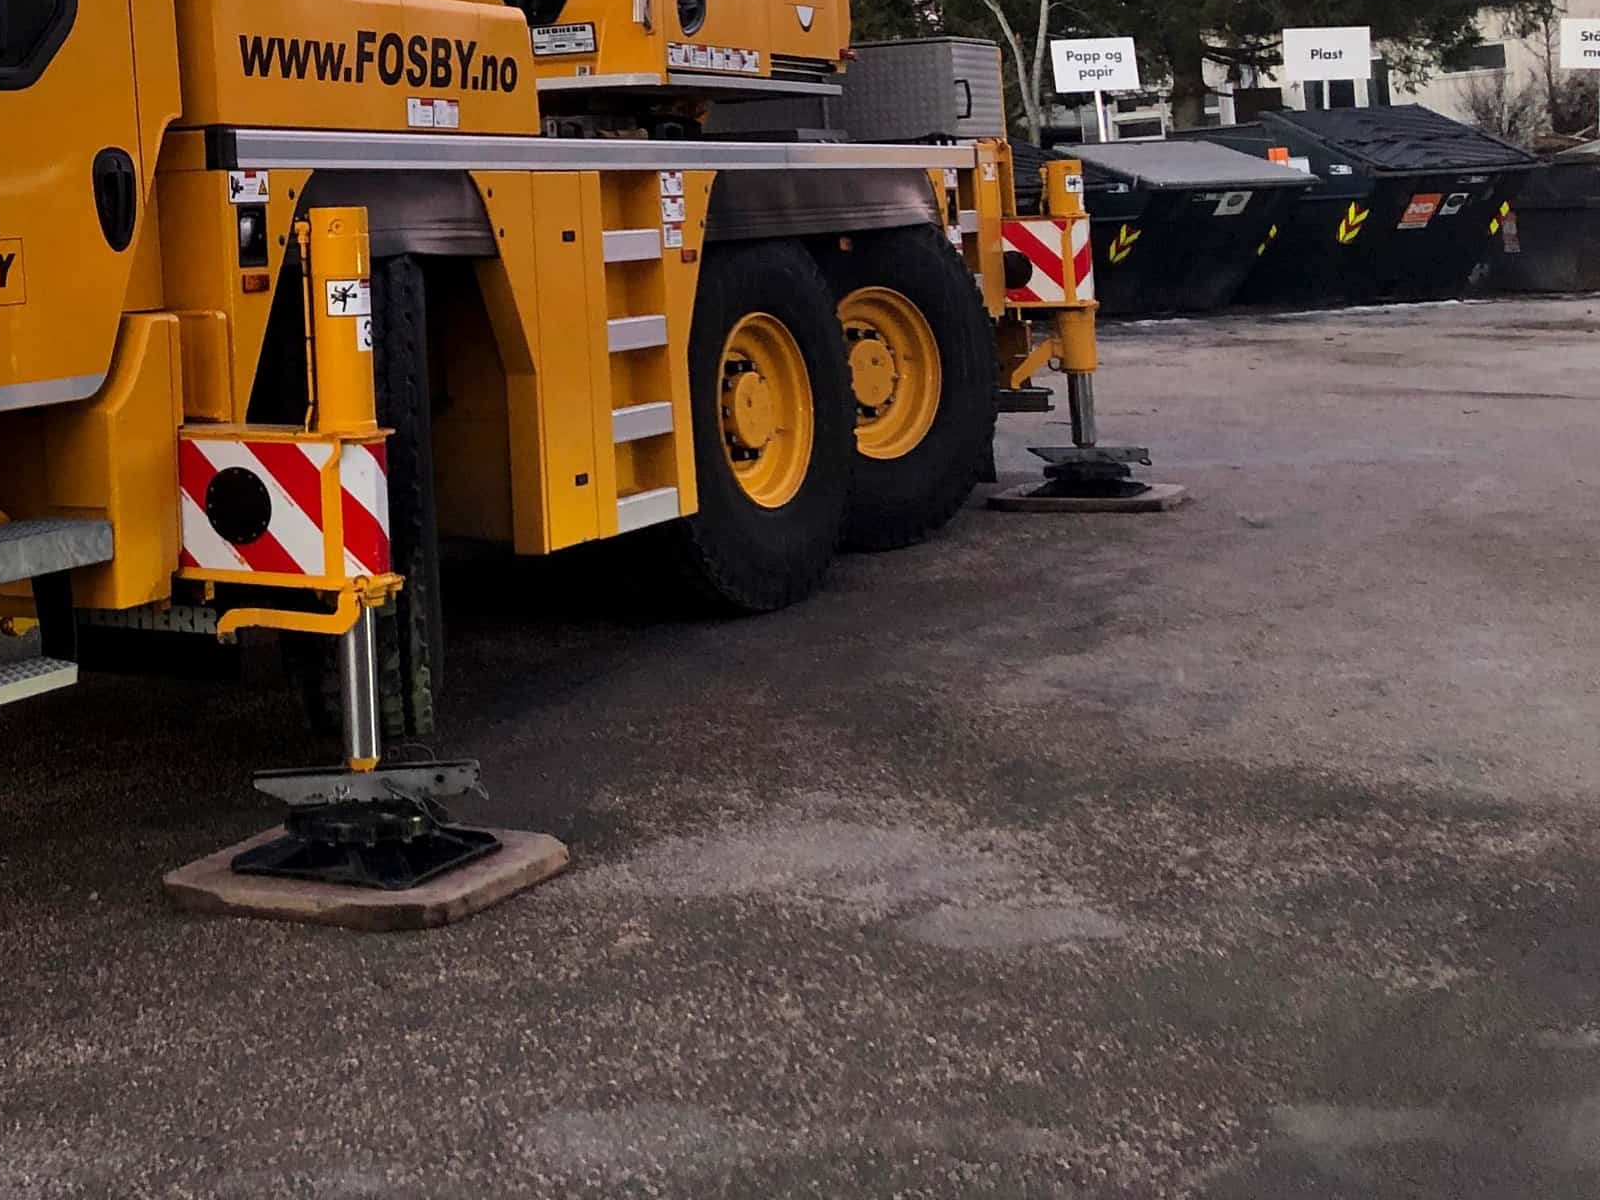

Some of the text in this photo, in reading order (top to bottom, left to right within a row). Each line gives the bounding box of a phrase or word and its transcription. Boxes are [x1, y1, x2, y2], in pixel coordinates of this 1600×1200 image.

[1066, 50, 1122, 64] Papp og
[1311, 48, 1343, 60] Plast
[1079, 65, 1114, 80] papir
